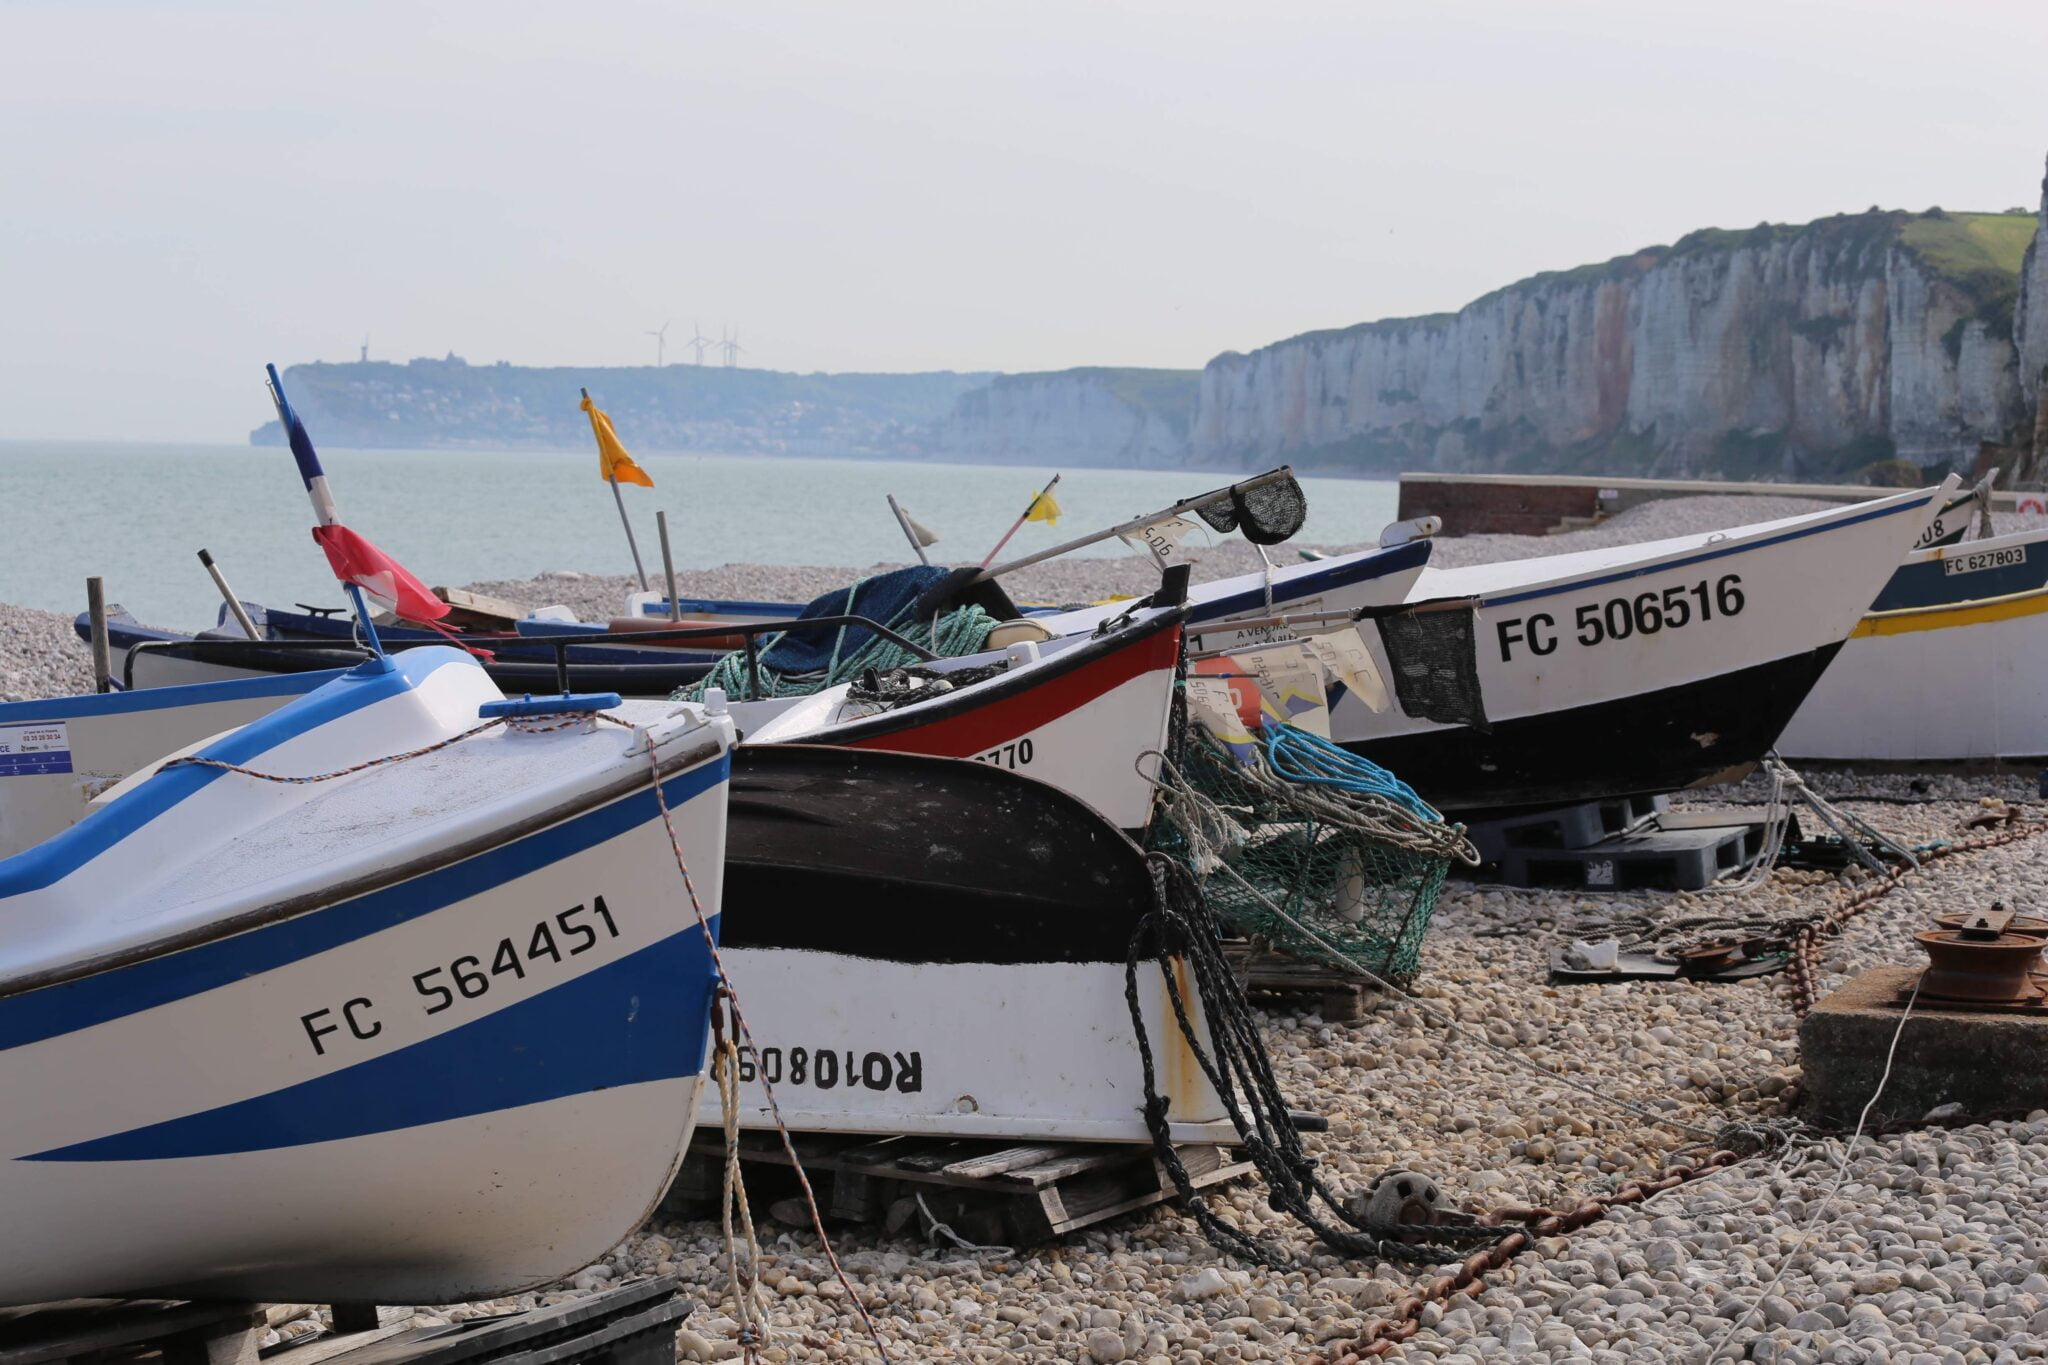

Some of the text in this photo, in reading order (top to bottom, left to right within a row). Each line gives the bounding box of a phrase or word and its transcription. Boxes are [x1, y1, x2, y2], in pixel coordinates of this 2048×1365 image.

[1945, 548, 2023, 574] FC 627803
[1496, 573, 1746, 663] FC 506516
[974, 738, 1034, 770] 770
[300, 895, 619, 1056] FC 564451
